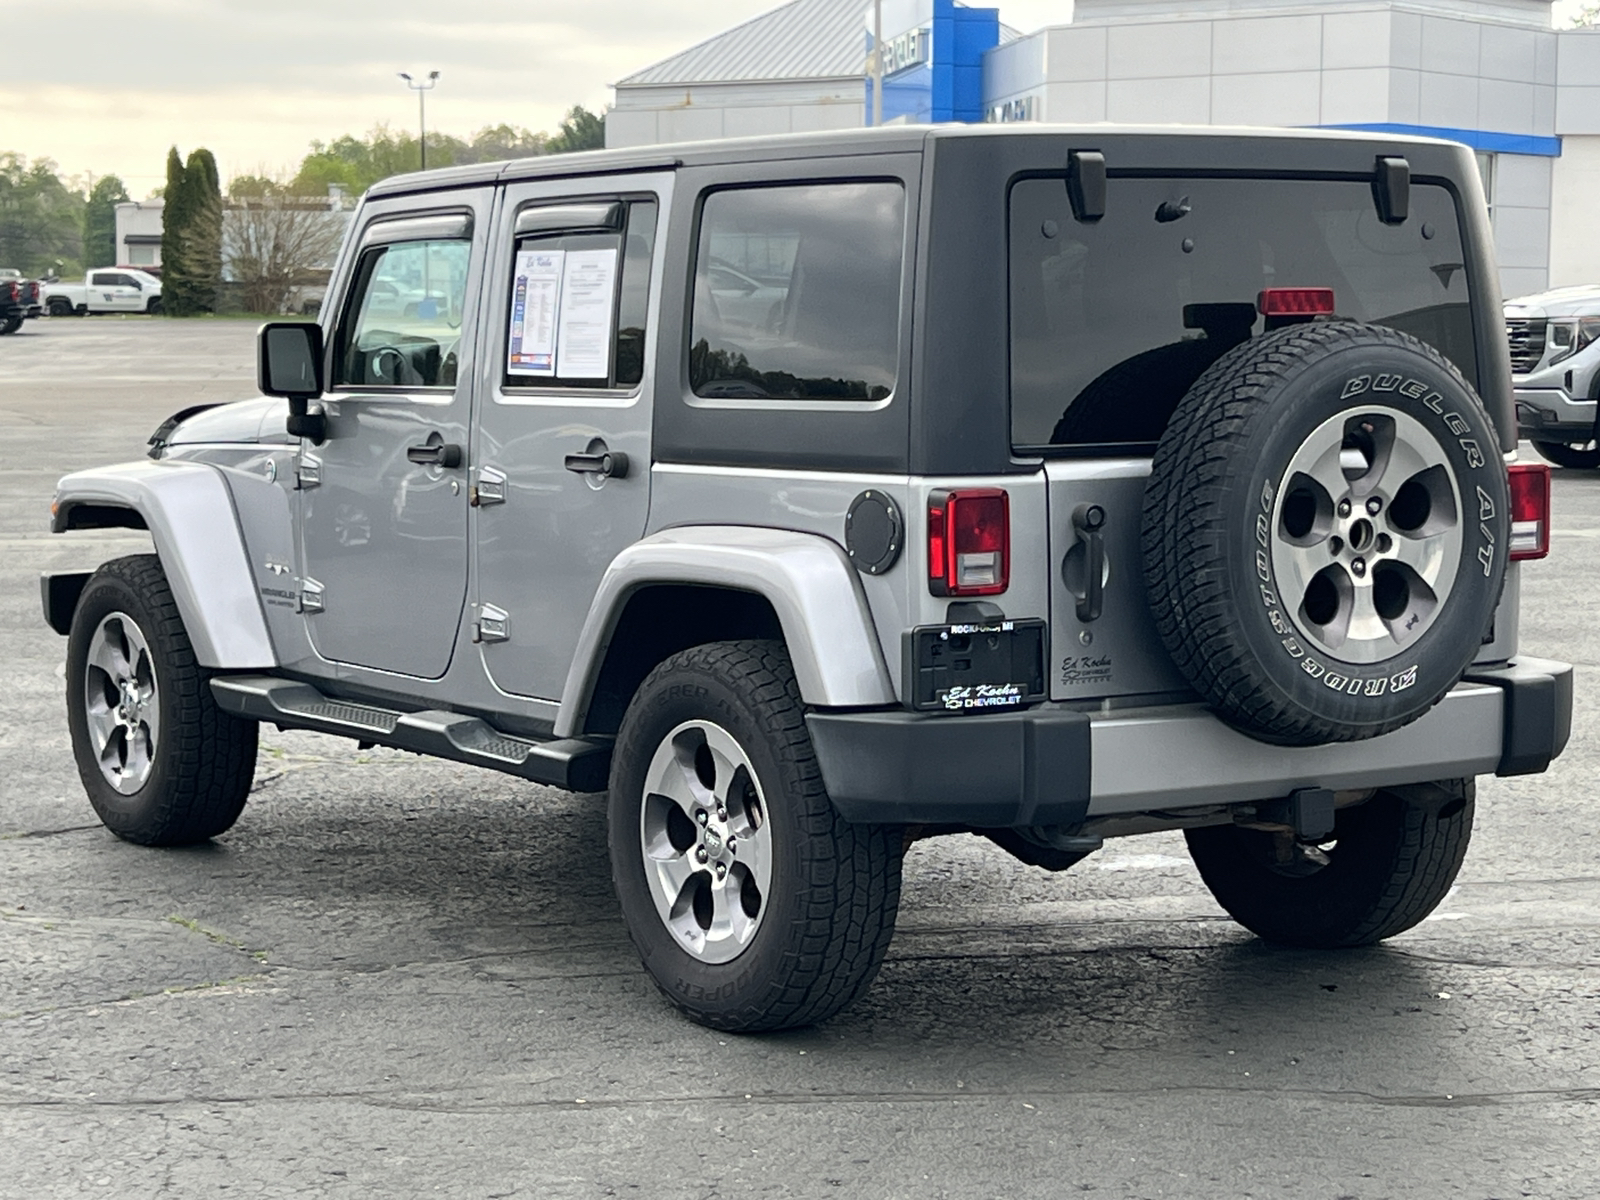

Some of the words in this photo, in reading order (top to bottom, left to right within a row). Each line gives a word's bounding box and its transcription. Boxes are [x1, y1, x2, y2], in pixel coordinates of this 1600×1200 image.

[1340, 374, 1485, 469] DUELER
[1476, 485, 1495, 577] A/T
[1255, 479, 1419, 696] BRIDGESTONE
[1061, 656, 1078, 671] Ed
[948, 686, 972, 700] Ed
[975, 683, 1019, 697] Koehn
[964, 695, 1021, 708] CHEVROLET
